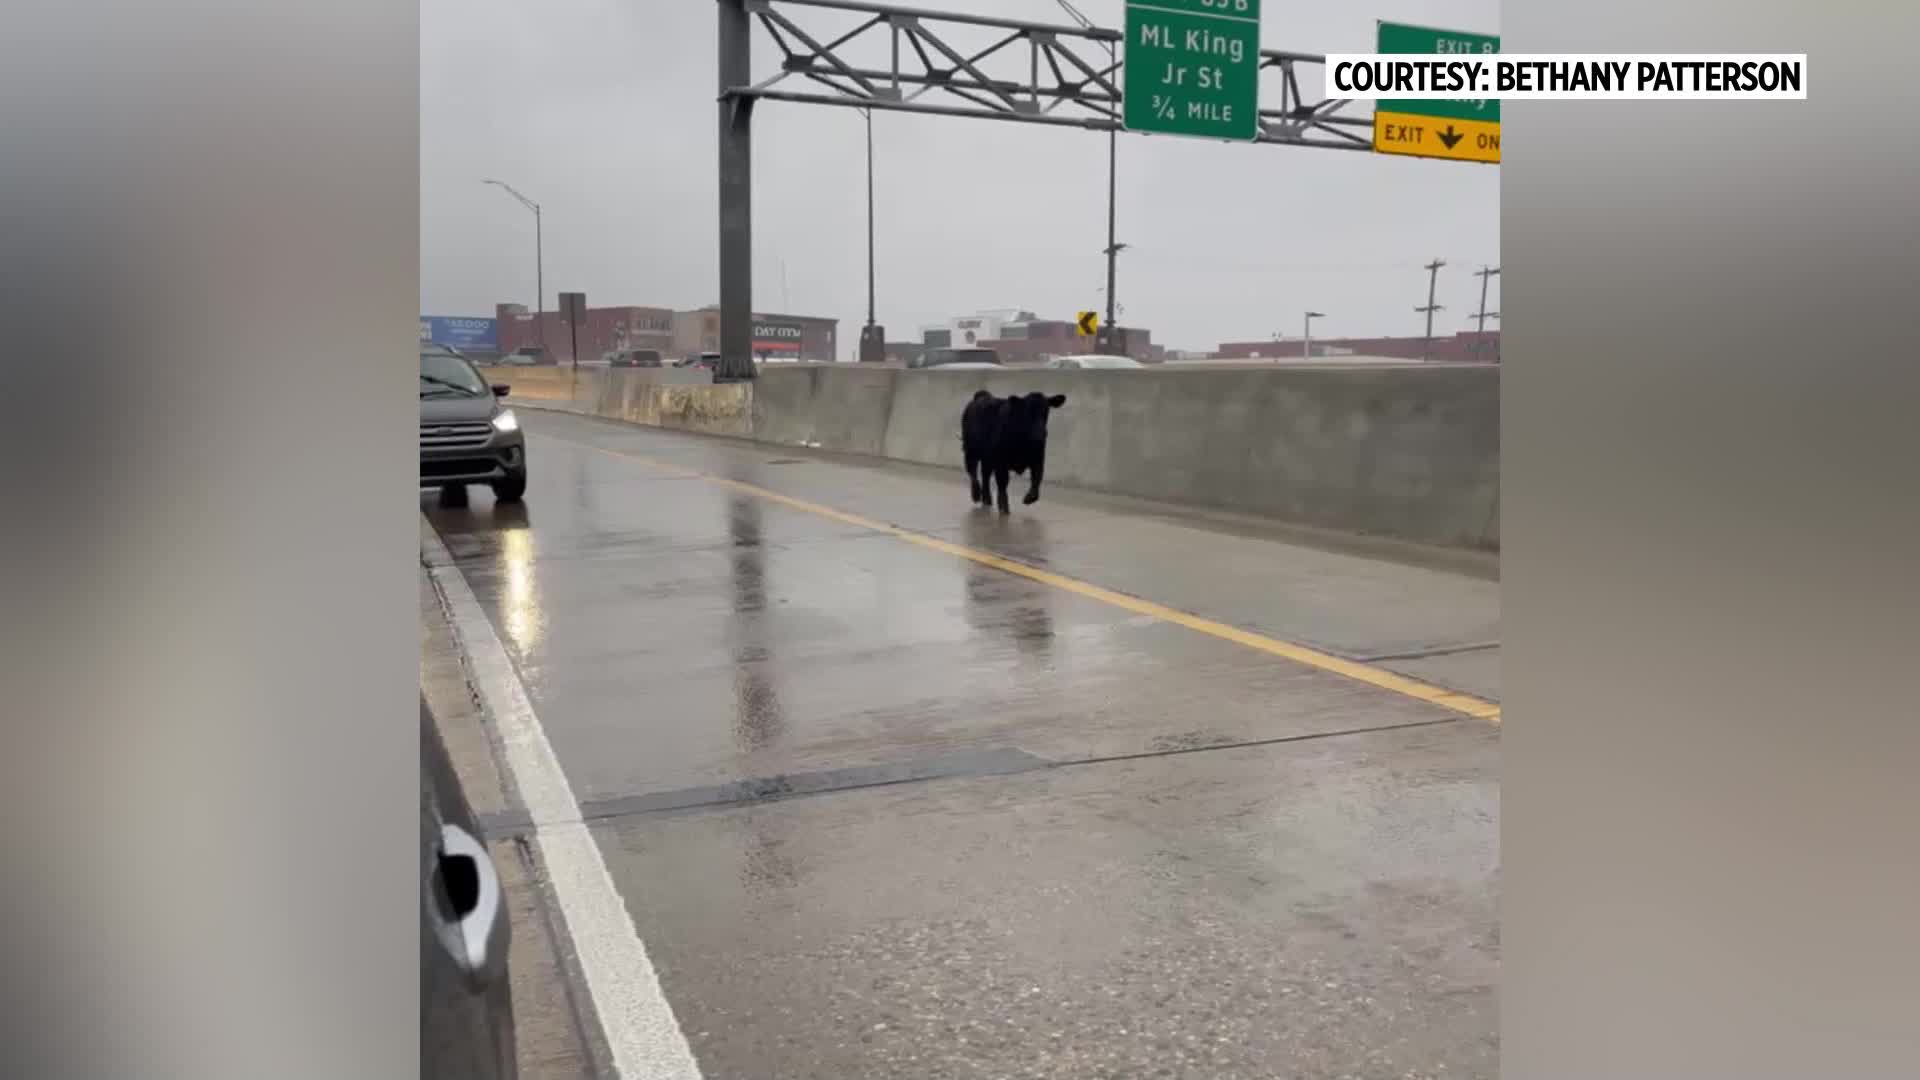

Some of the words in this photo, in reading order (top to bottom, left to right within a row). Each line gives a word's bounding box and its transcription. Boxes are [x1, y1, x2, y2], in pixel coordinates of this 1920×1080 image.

[1140, 23, 1175, 49] ML
[1185, 29, 1244, 62] King
[1436, 38, 1473, 54] EXIT
[1161, 63, 1187, 85] Jr
[1197, 66, 1223, 90] St
[1187, 101, 1232, 122] MILE
[1384, 124, 1424, 144] EXIT
